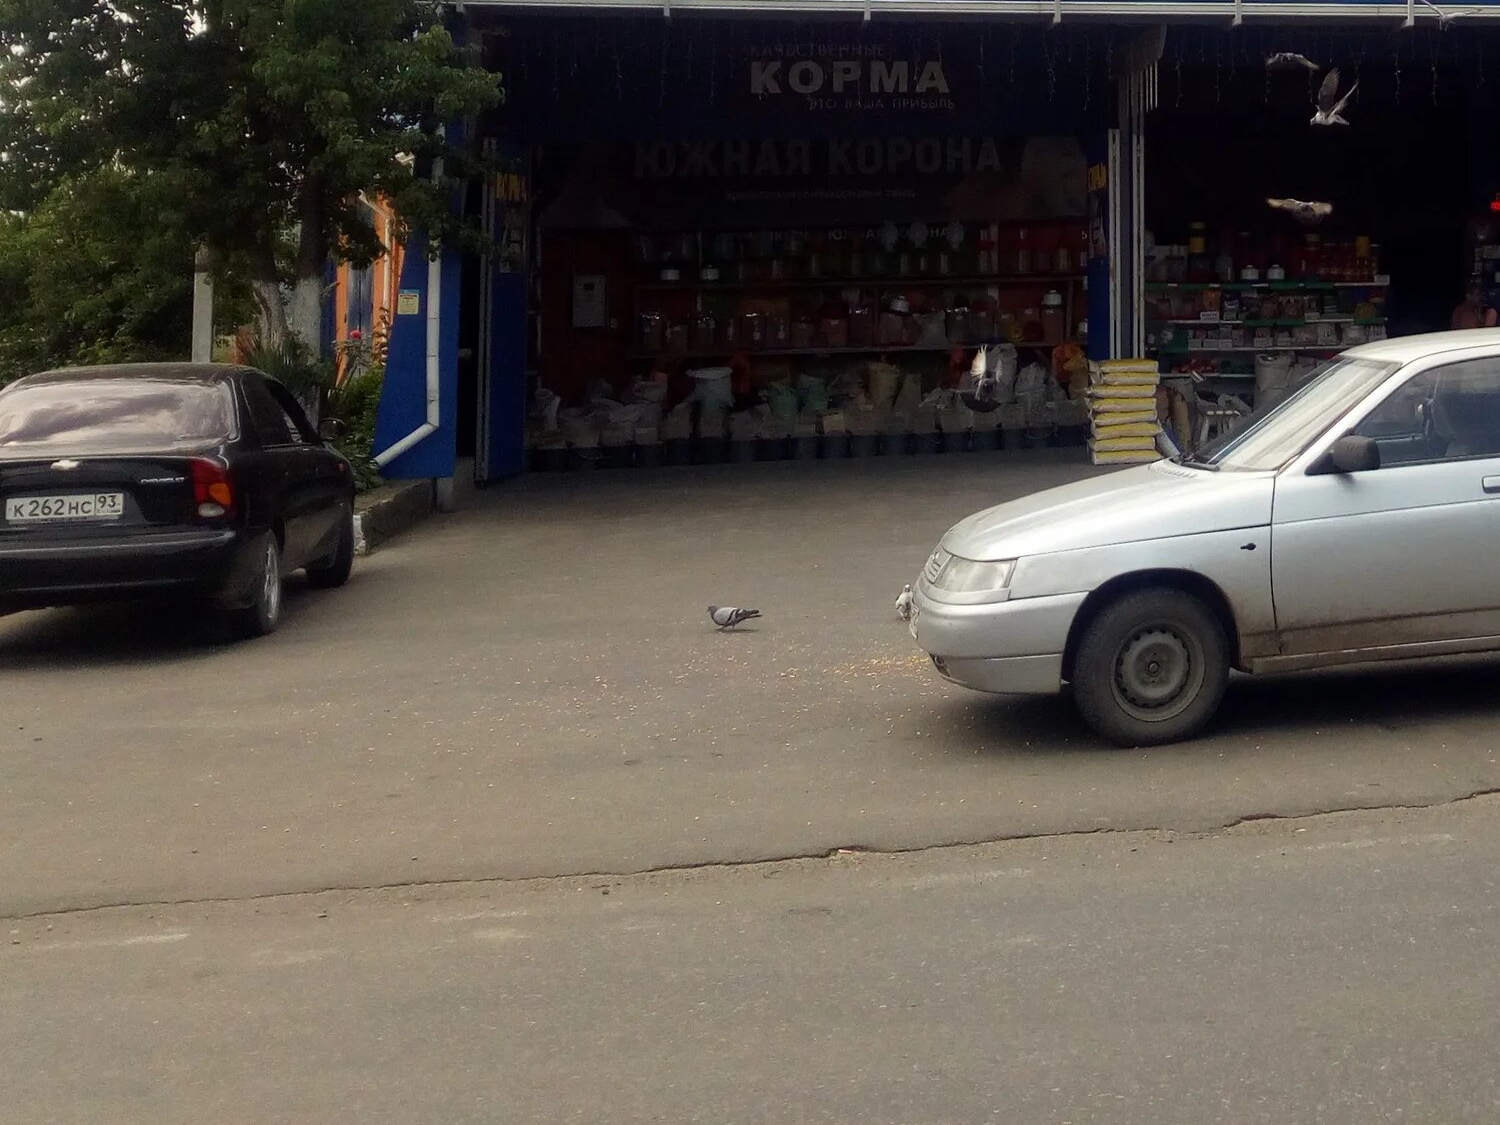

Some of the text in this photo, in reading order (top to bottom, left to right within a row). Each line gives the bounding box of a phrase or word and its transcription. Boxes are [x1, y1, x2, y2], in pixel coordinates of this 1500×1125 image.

[750, 61, 951, 94] КОРМА
[634, 137, 1001, 177] ЮЖНАЯ КОРОНА
